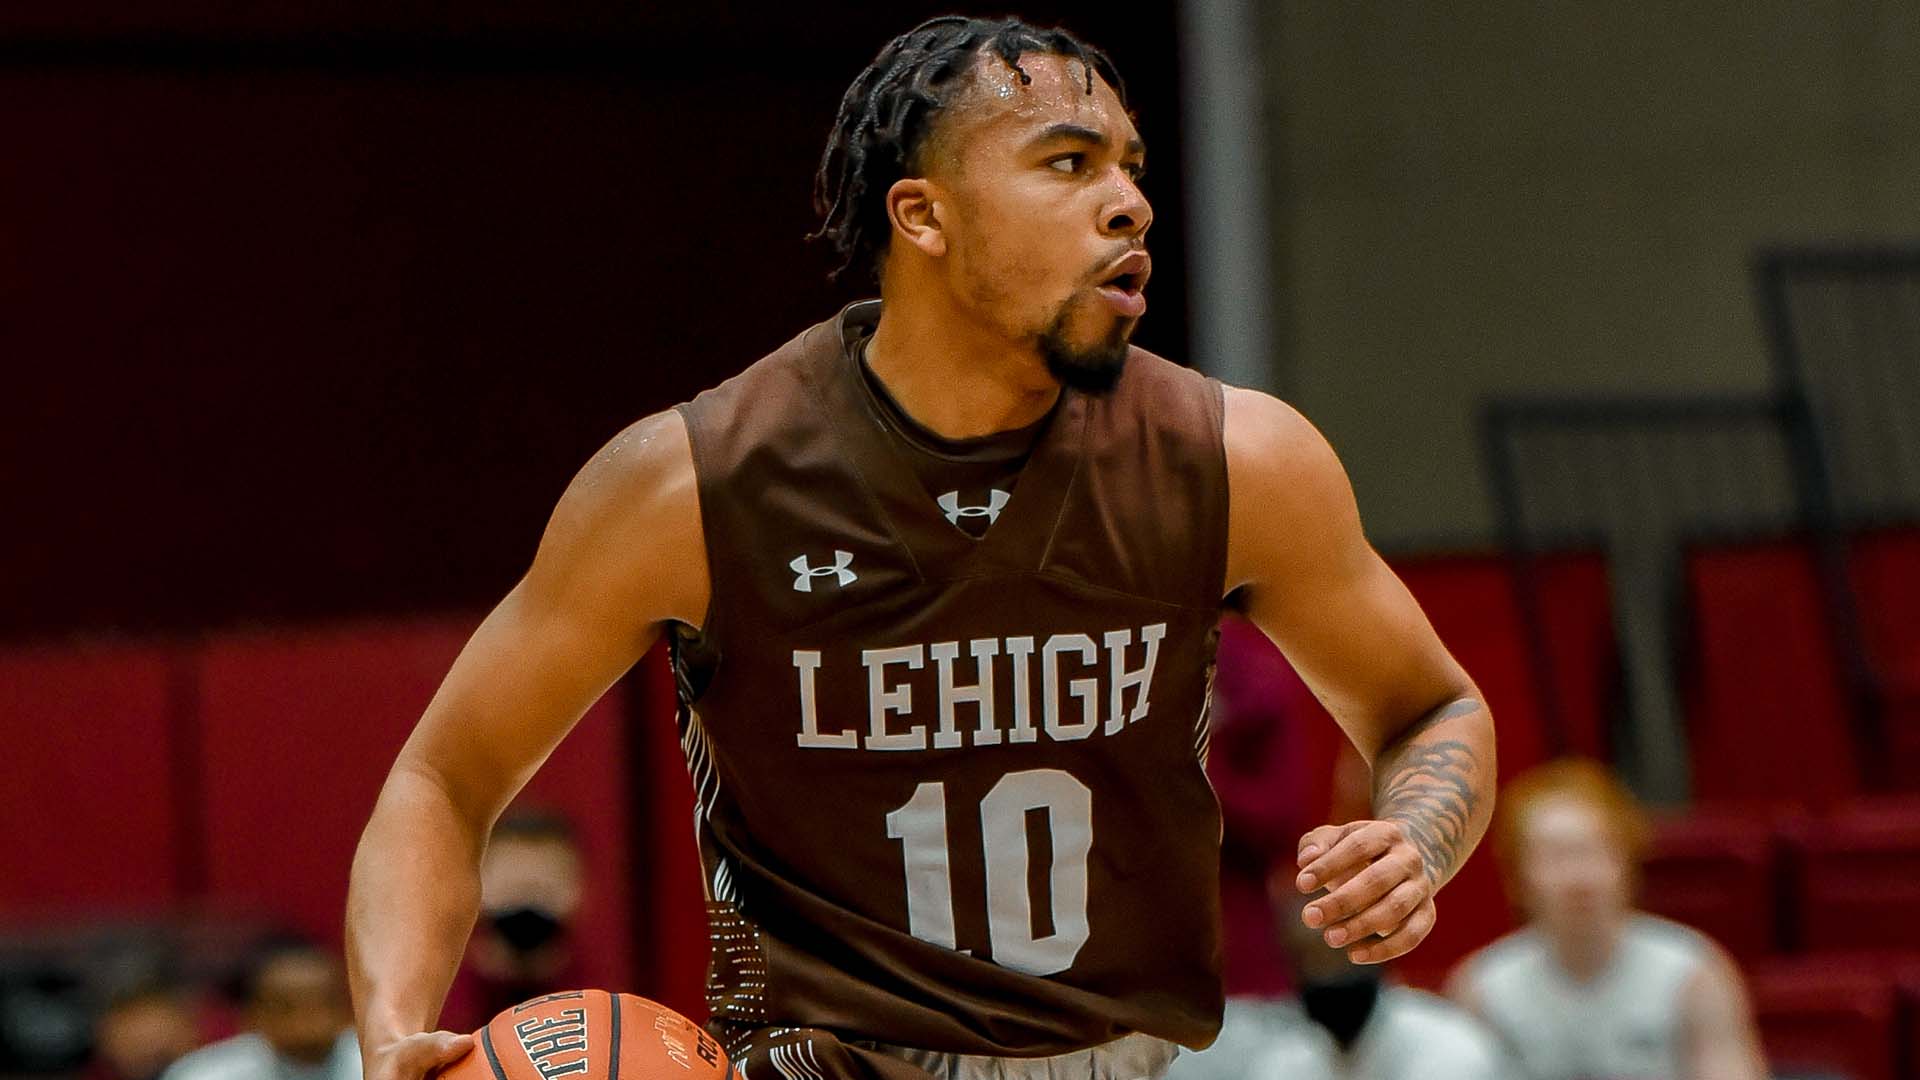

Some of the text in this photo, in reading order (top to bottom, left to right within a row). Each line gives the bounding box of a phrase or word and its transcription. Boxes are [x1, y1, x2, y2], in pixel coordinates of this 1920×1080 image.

[793, 623, 1167, 750] LEHIGH
[886, 769, 1093, 976] 10
[514, 1008, 588, 1080] THE
